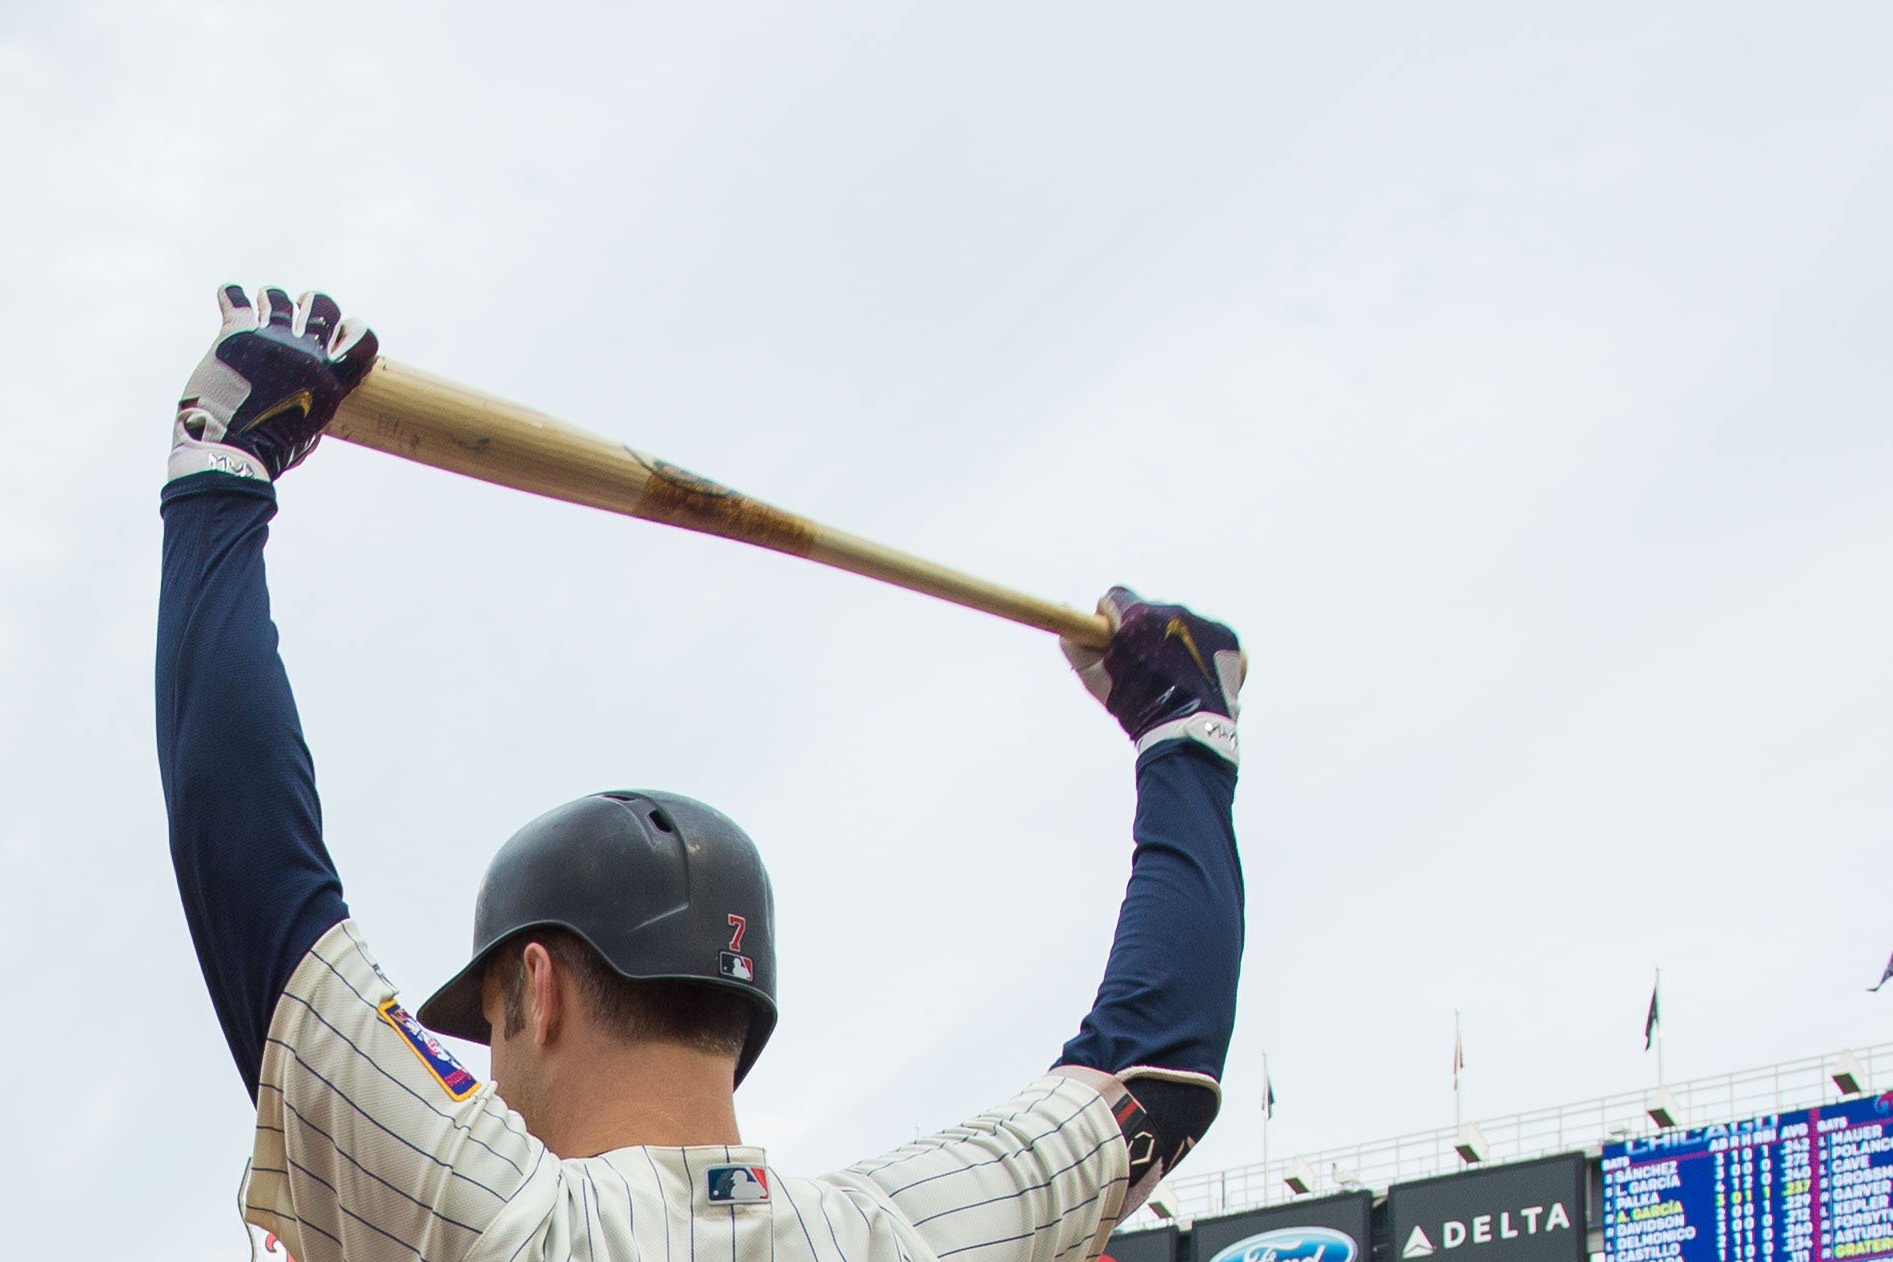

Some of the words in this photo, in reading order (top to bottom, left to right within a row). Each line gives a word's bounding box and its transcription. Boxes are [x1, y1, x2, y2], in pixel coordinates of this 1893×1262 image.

[728, 913, 746, 952] 7
[1443, 1202, 1571, 1249] DELTA
[1618, 1227, 1695, 1250] DELMONICO
